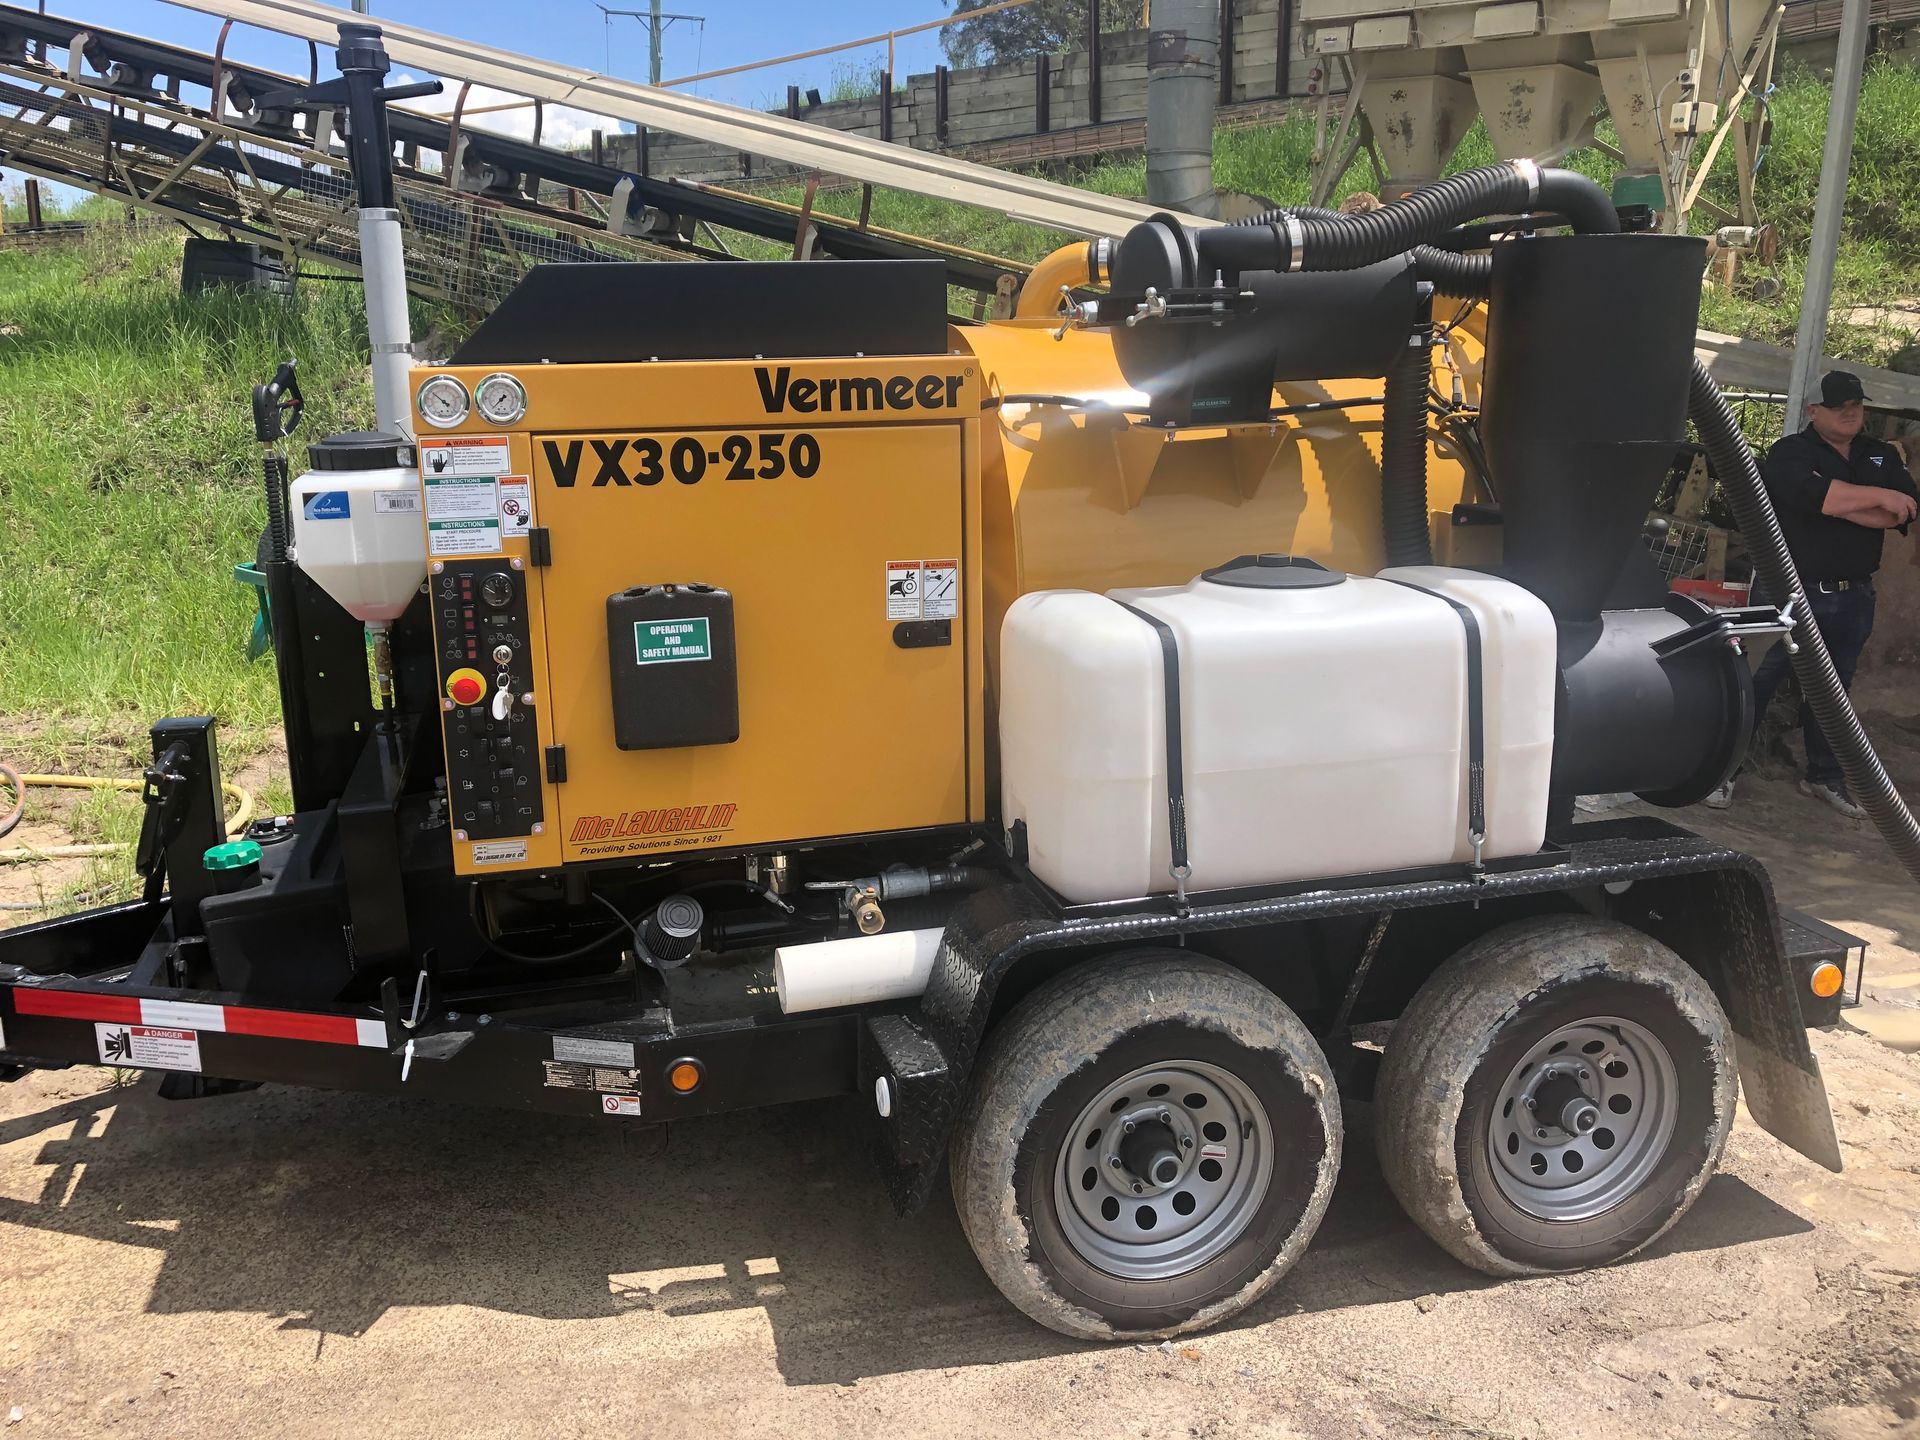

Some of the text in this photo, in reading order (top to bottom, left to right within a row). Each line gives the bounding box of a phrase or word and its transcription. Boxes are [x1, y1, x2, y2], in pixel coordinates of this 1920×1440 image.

[542, 432, 821, 488] VX30-250
[441, 520, 485, 529] INSTRUCTIONS
[650, 624, 694, 635] OPERATION
[664, 636, 681, 645] AND
[642, 645, 704, 658] SAFETY MANUAL
[580, 834, 722, 855] Providing Solutions Since 1921
[151, 1030, 183, 1039] DANGER
